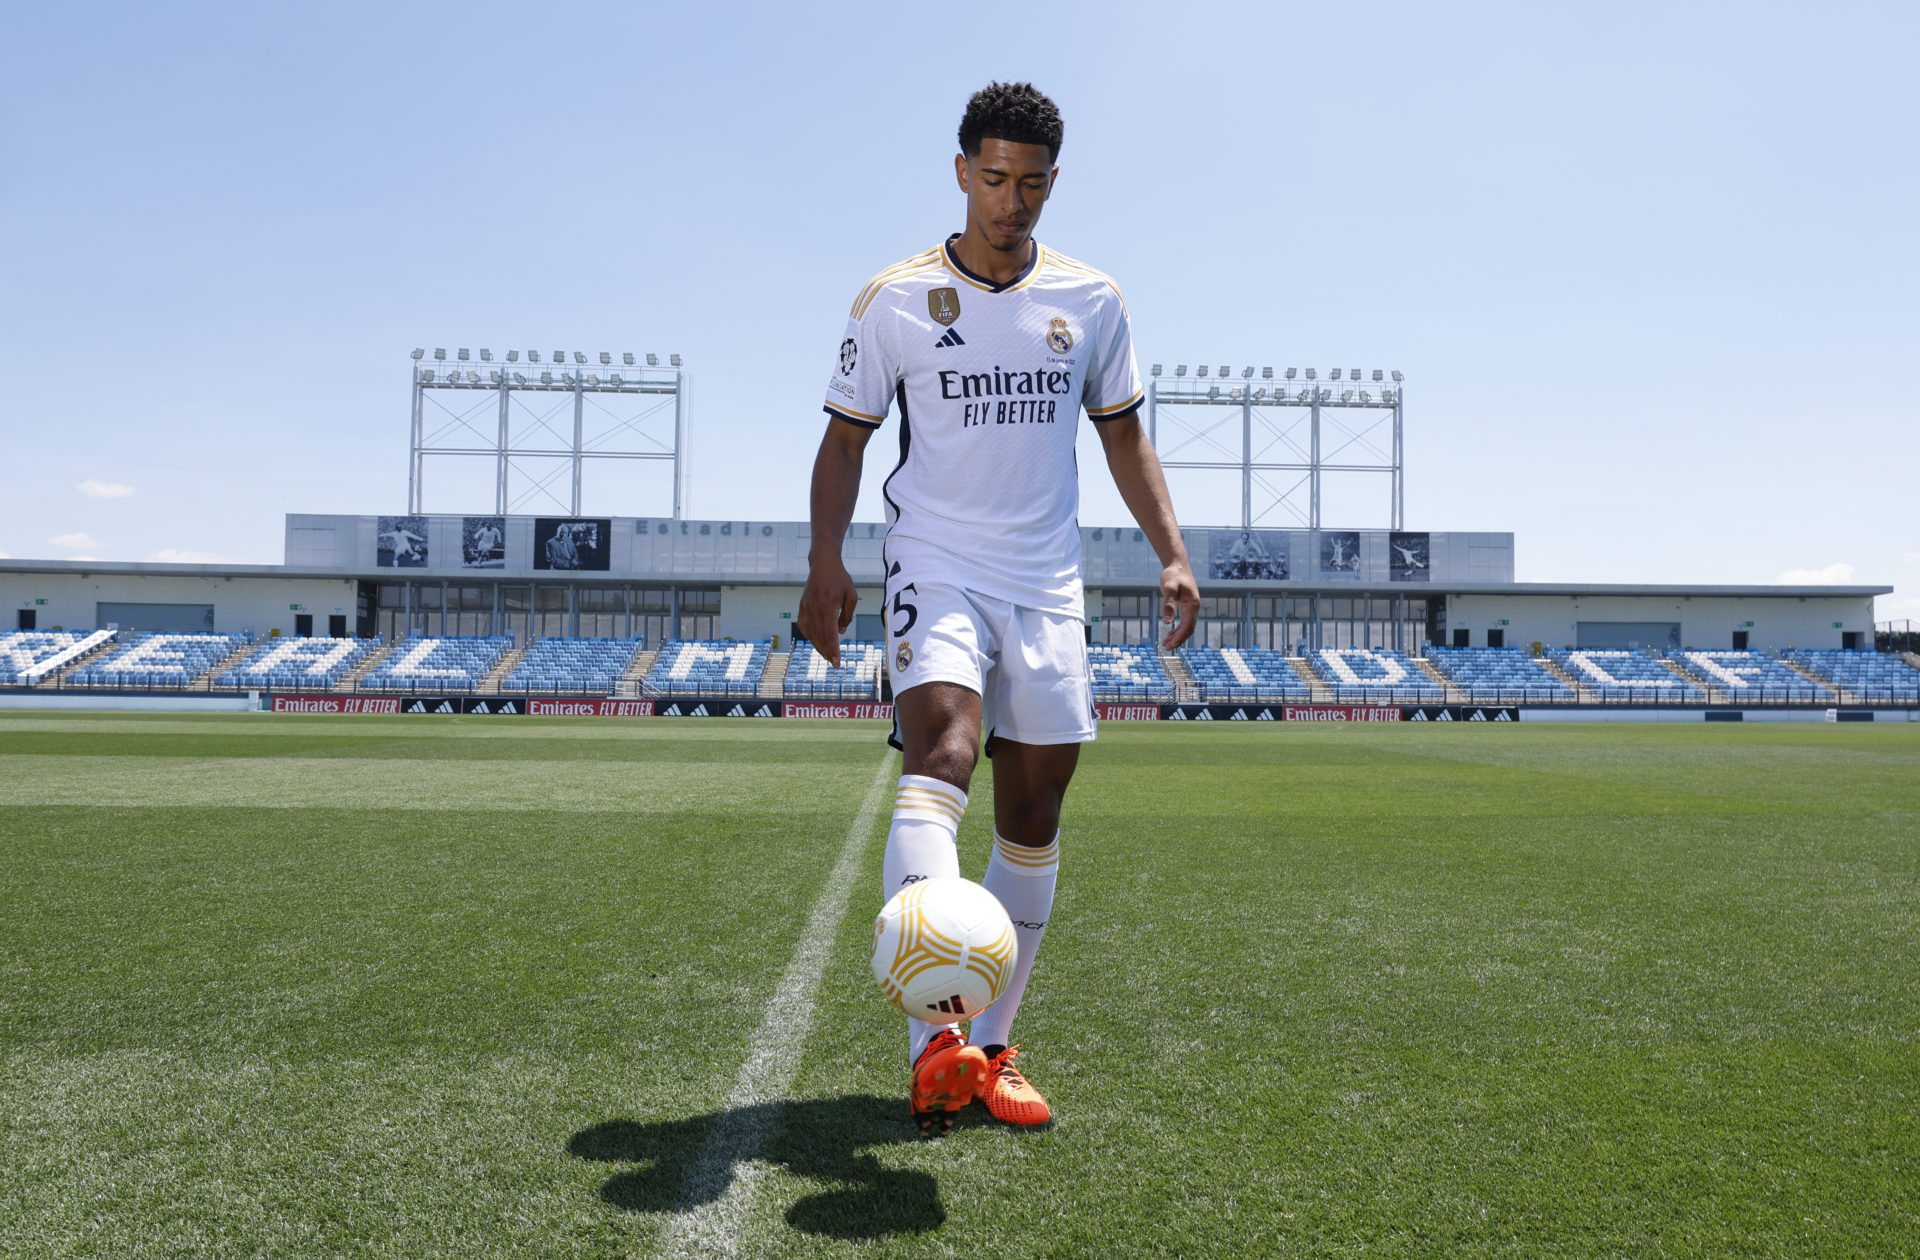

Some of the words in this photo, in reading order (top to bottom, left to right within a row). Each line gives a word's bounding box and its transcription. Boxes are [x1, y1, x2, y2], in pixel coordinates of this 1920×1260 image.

[938, 366, 1071, 399] Emirates
[964, 402, 989, 427] FLY
[996, 400, 1055, 425] BETTER
[636, 520, 774, 536] Estadio
[894, 582, 918, 637] 5
[275, 698, 339, 712] Emirates
[344, 698, 361, 713] FLY
[362, 699, 397, 713] BETTER
[530, 701, 594, 715] Emirates
[600, 702, 616, 716] FLY
[617, 702, 652, 716] BETTER
[785, 704, 850, 718] Emirates
[855, 705, 871, 718] FLY
[873, 705, 894, 718] BETT
[1107, 706, 1122, 720] FLY
[1125, 707, 1158, 720] BETTER
[1285, 707, 1347, 721] Emirates
[1351, 708, 1366, 721] FLY
[1369, 708, 1400, 722] BETTER
